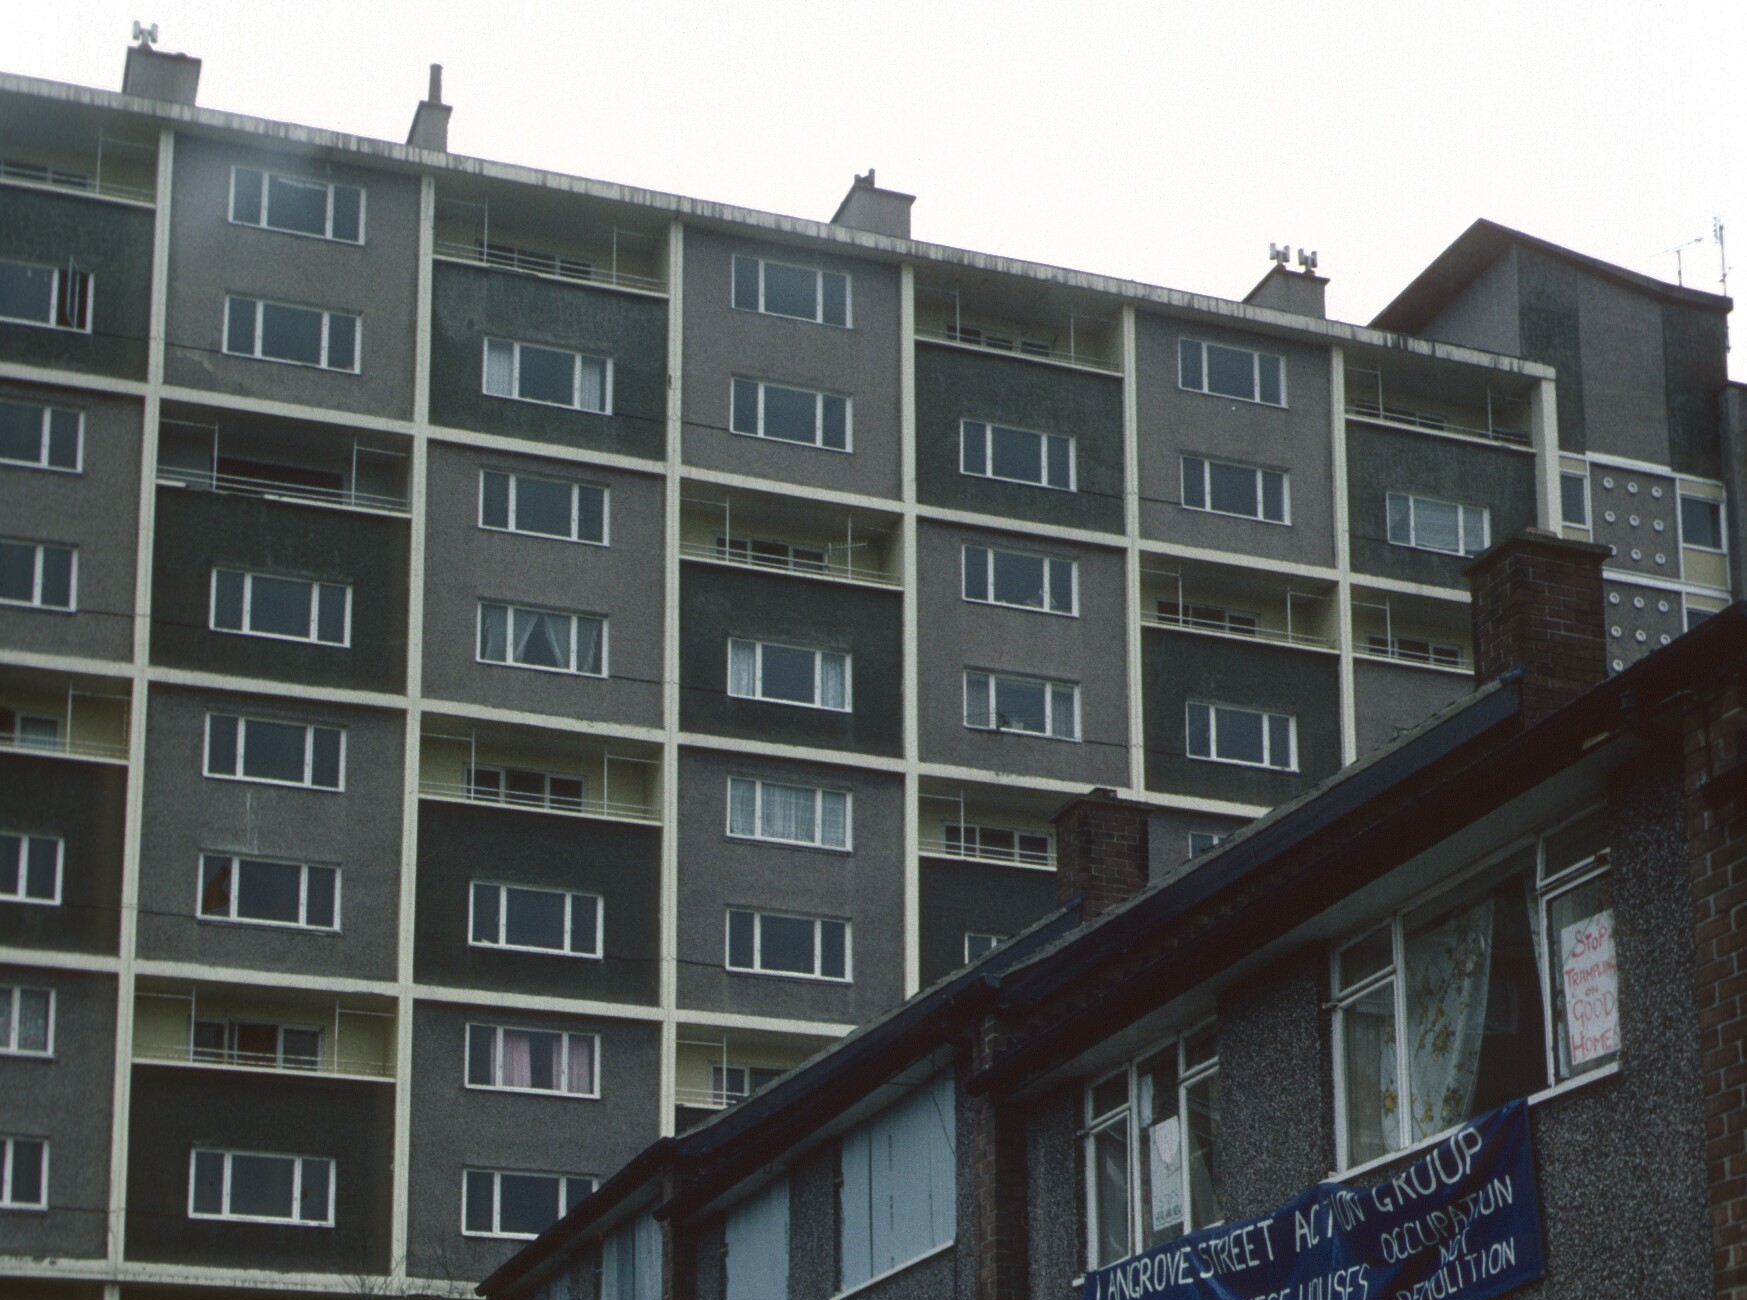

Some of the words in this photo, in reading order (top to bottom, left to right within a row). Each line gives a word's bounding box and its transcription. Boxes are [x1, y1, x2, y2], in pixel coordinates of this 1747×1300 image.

[1573, 990, 1614, 1026] GOOD
[1198, 1219, 1274, 1278] STREET
[1295, 1190, 1365, 1252] ACTION
[1380, 1174, 1513, 1264] OCCUPATION
